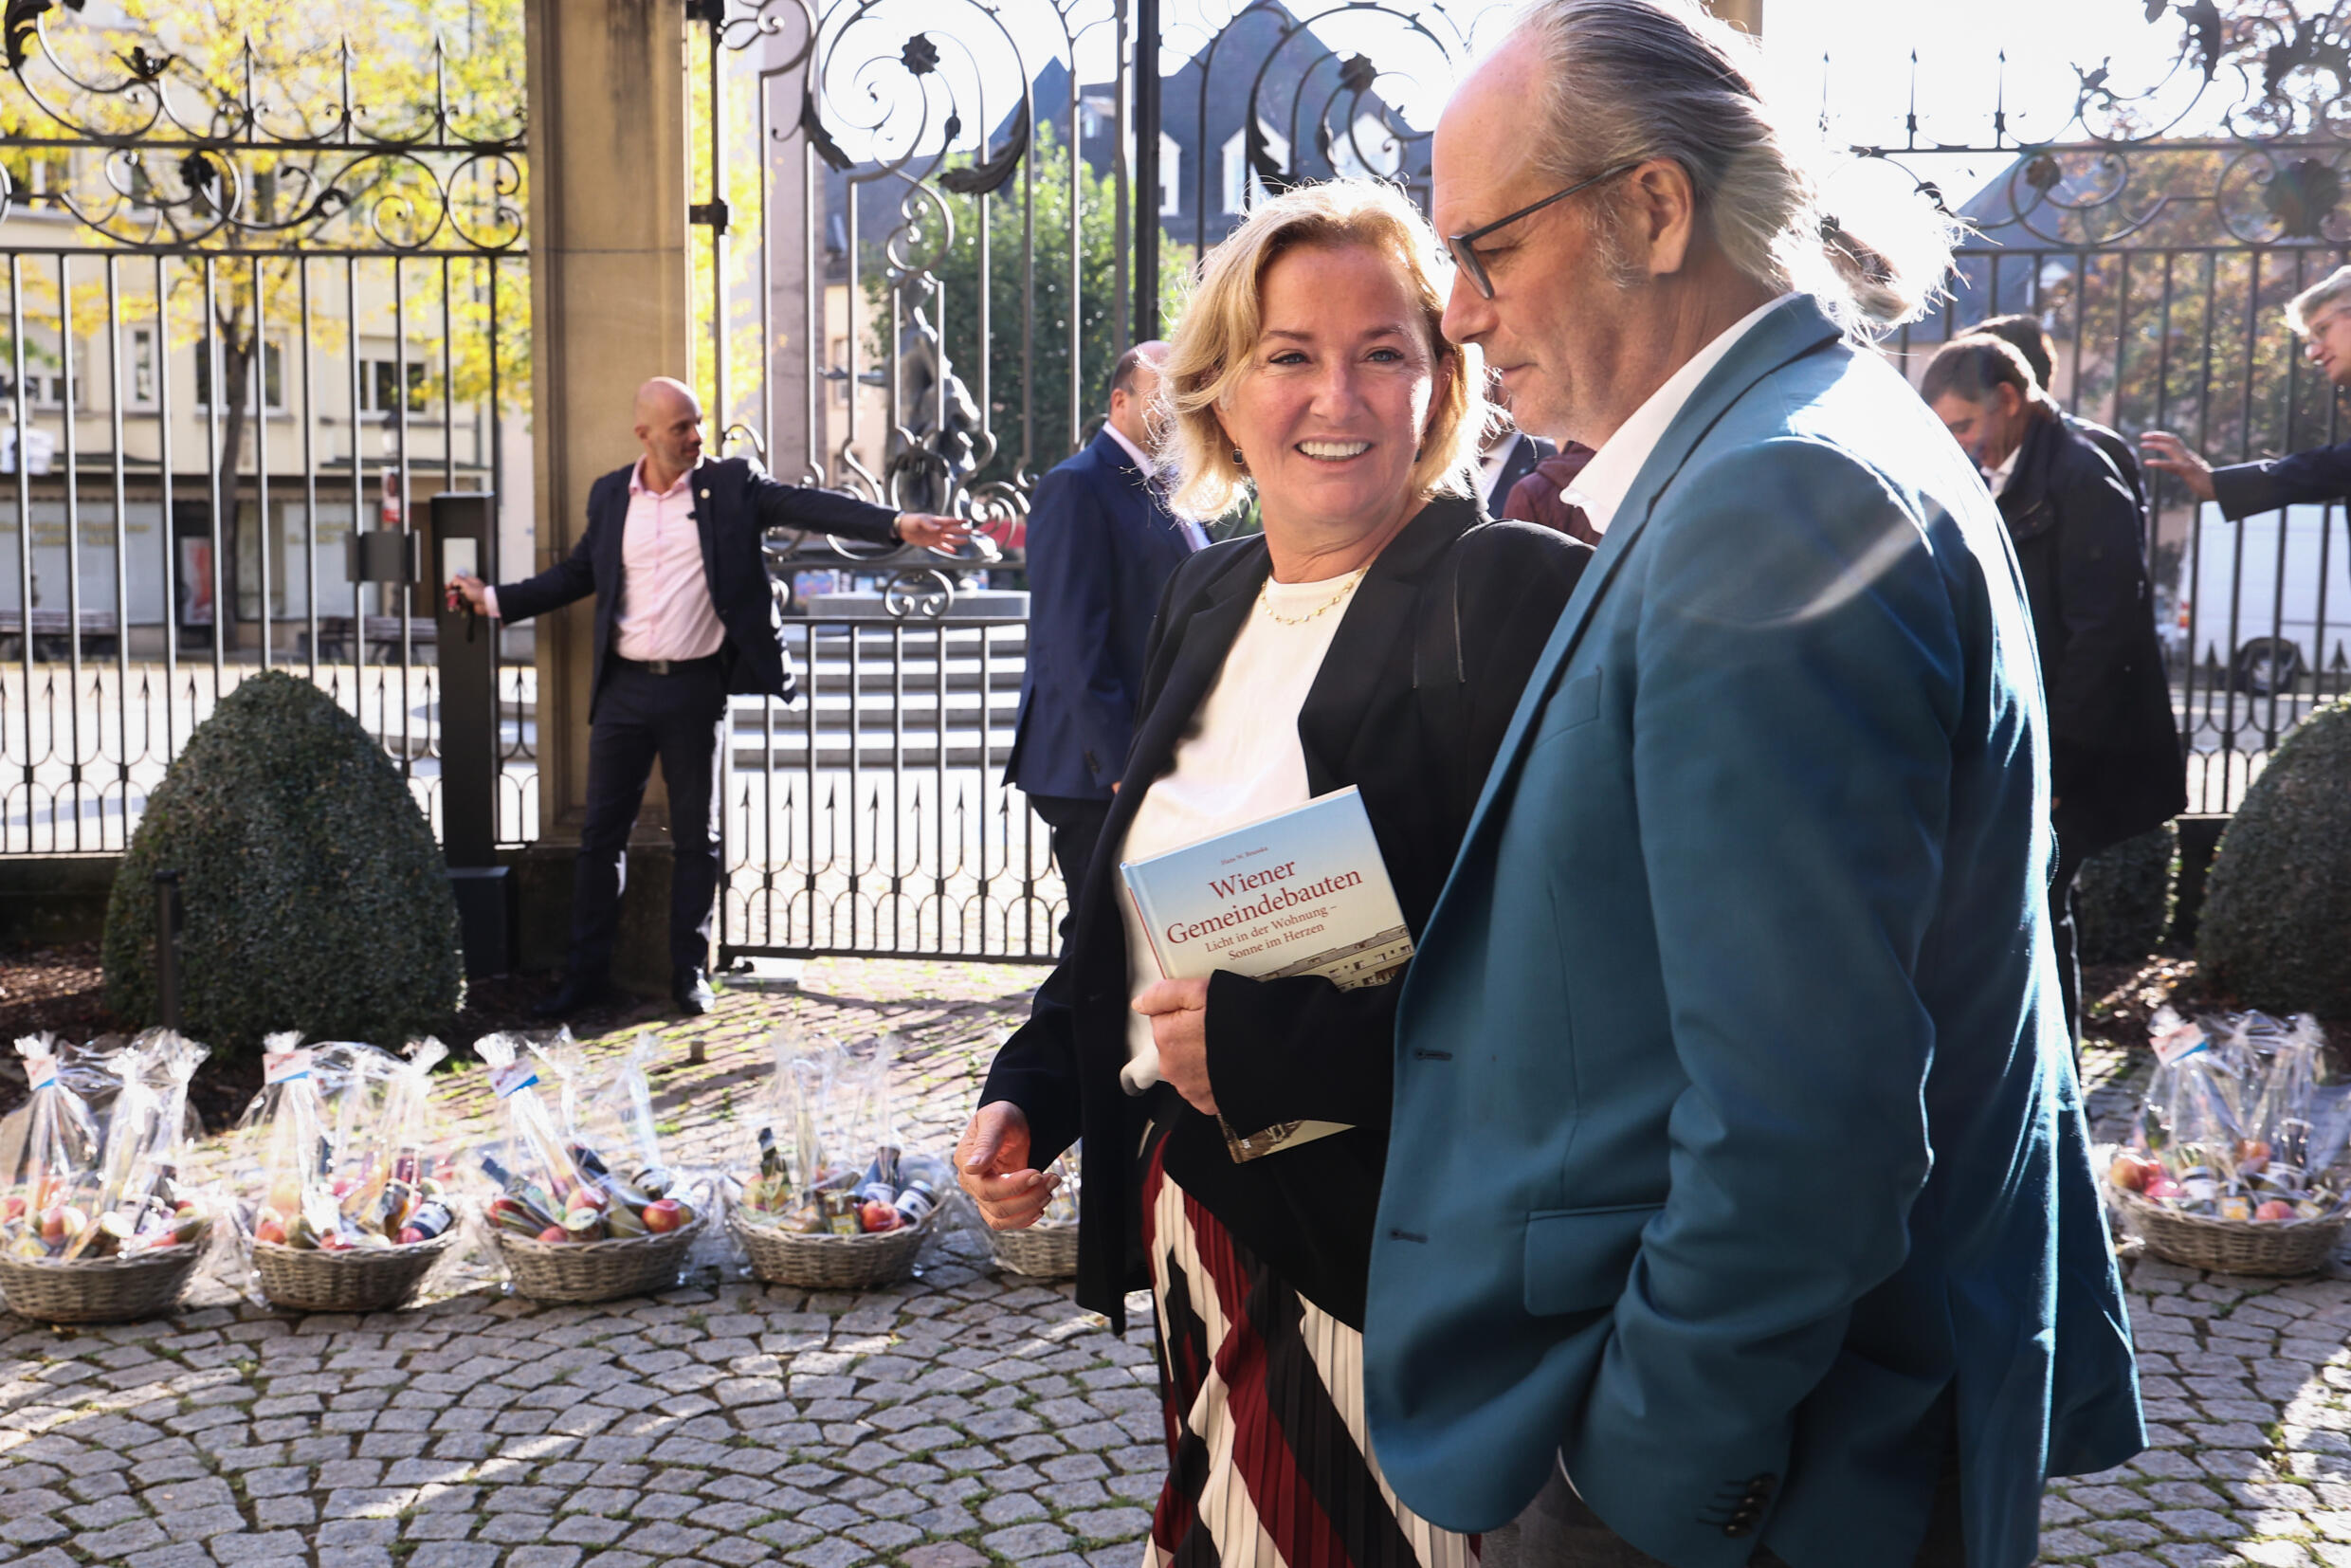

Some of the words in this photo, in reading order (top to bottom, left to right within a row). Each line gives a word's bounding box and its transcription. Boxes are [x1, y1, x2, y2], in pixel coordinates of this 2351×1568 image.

[1208, 860, 1297, 900] Wiener
[1166, 869, 1364, 944] Gemeindebauten
[1205, 933, 1235, 953] Licht
[1236, 929, 1249, 943] in
[1250, 924, 1269, 939] der
[1270, 905, 1329, 931] Wohnung
[1229, 941, 1265, 961] Sonne
[1266, 937, 1283, 950] im
[1284, 921, 1325, 943] Herzen
